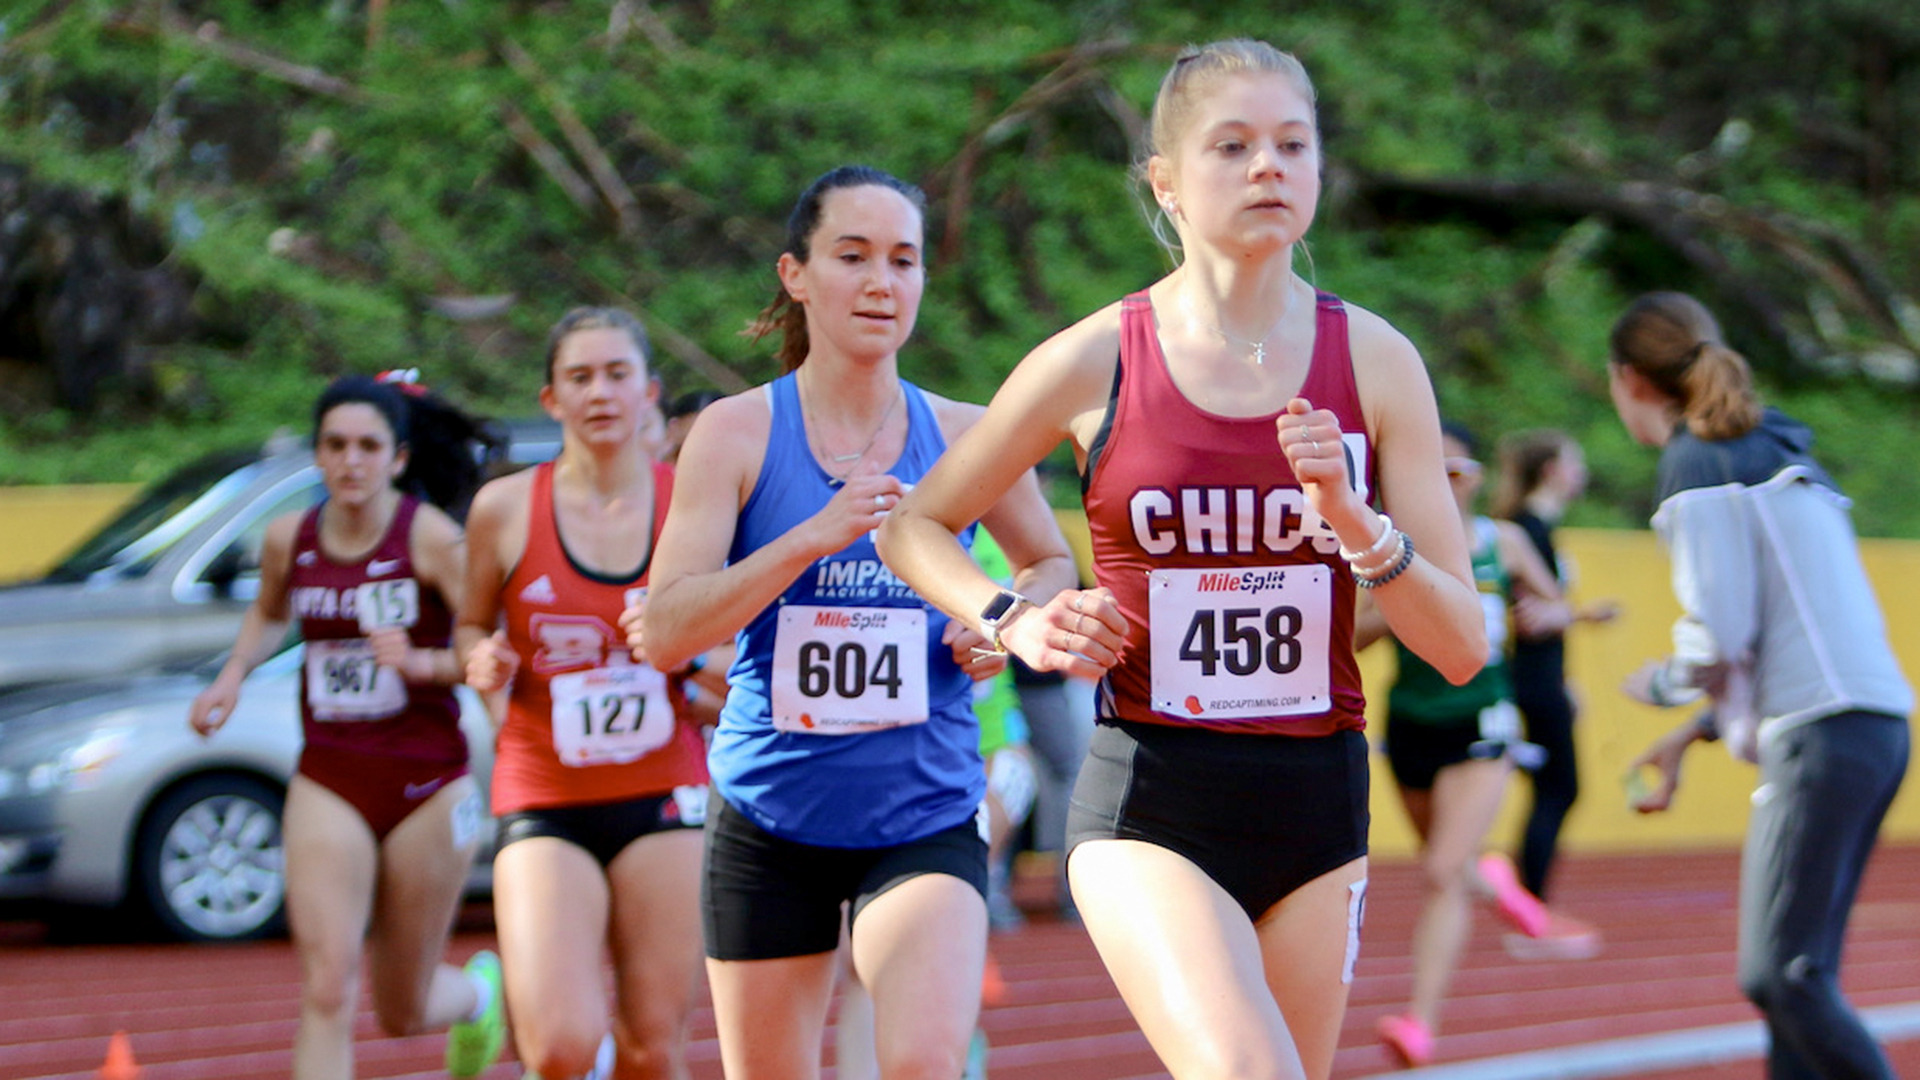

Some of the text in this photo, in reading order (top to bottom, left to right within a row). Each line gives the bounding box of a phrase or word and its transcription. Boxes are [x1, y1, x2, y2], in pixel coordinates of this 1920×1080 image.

[814, 587, 879, 598] RACING
[1197, 571, 1286, 594] MileSplit
[370, 582, 407, 622] 15
[814, 611, 888, 631] MileSplit
[1179, 605, 1303, 677] 458
[798, 640, 903, 699] 604
[577, 693, 647, 735] 127
[1209, 696, 1302, 710] REDCAPTIMING.COM
